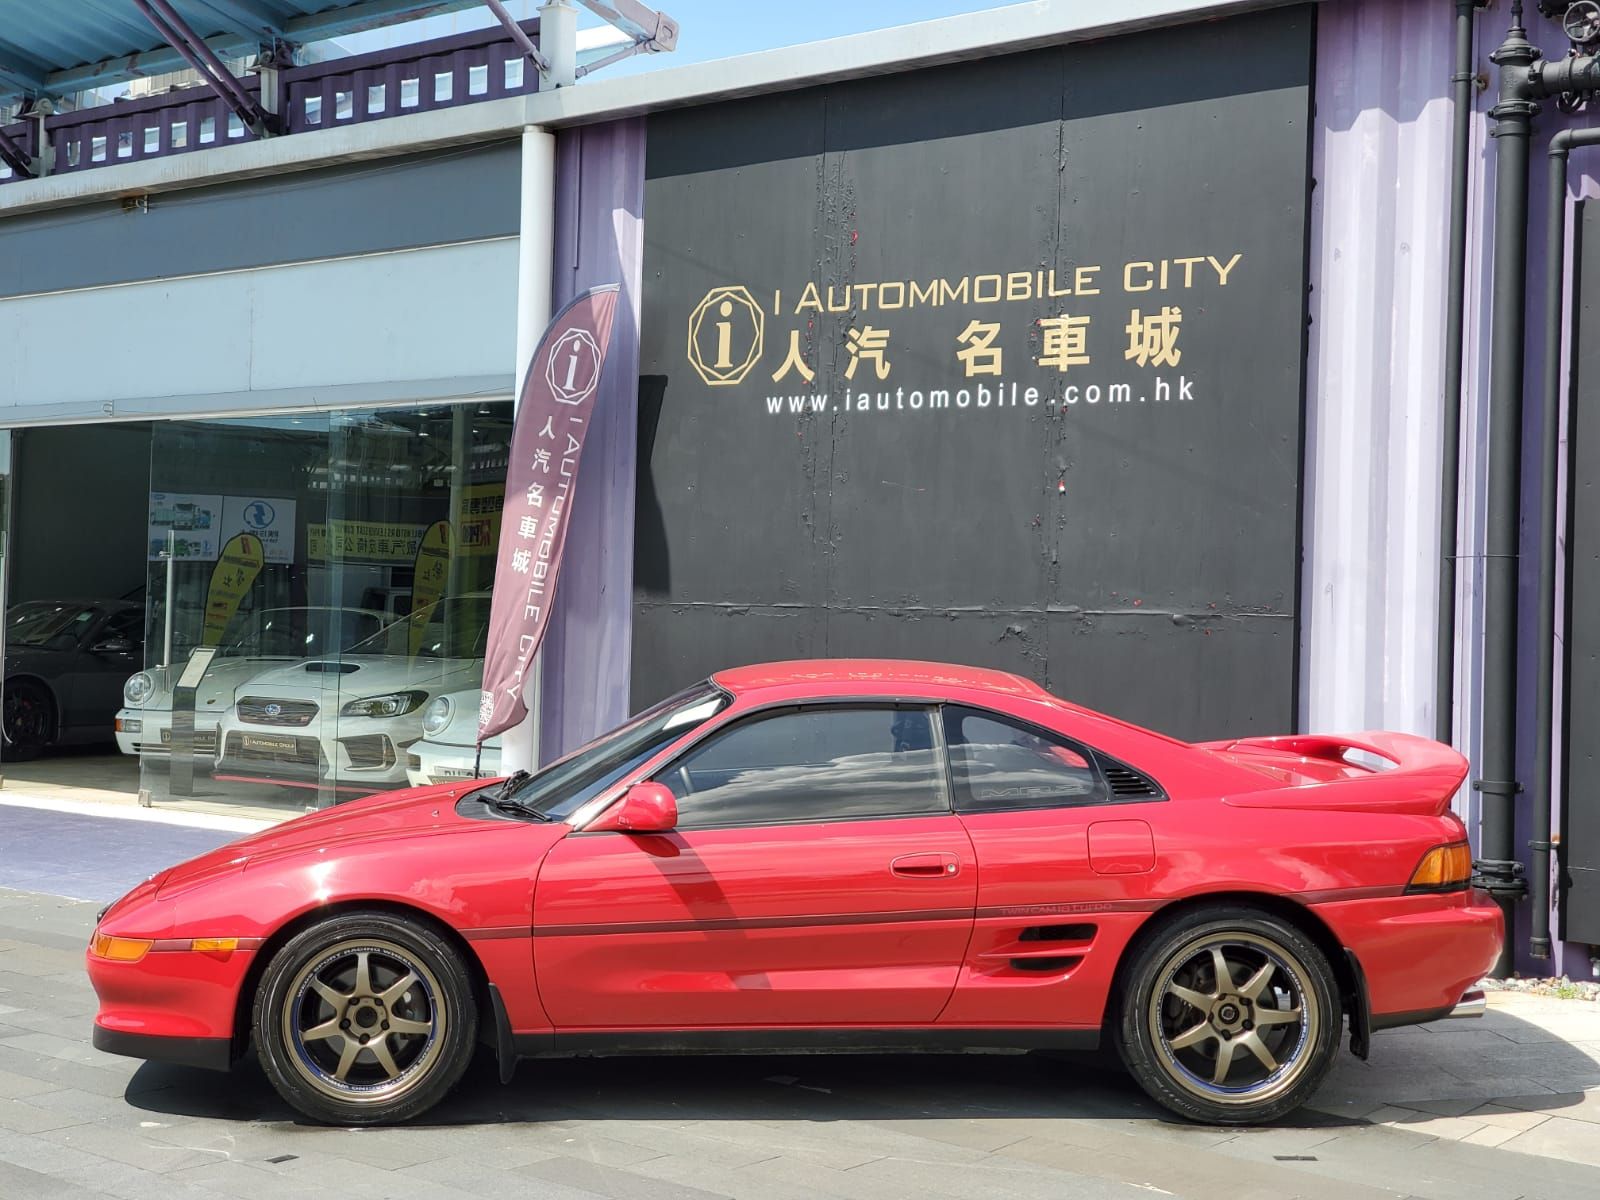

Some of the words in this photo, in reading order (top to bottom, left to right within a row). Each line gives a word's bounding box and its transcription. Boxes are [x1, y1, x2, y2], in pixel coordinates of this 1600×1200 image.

[774, 289, 781, 316] I
[794, 265, 1101, 314] AUTOMMOBILE
[1123, 254, 1242, 293] CITY
[771, 306, 1183, 383] 人汽名車城
[766, 376, 1195, 414] www.iautomobile.com.hk
[511, 415, 556, 574] 人汽名車城
[506, 634, 535, 701] CITY
